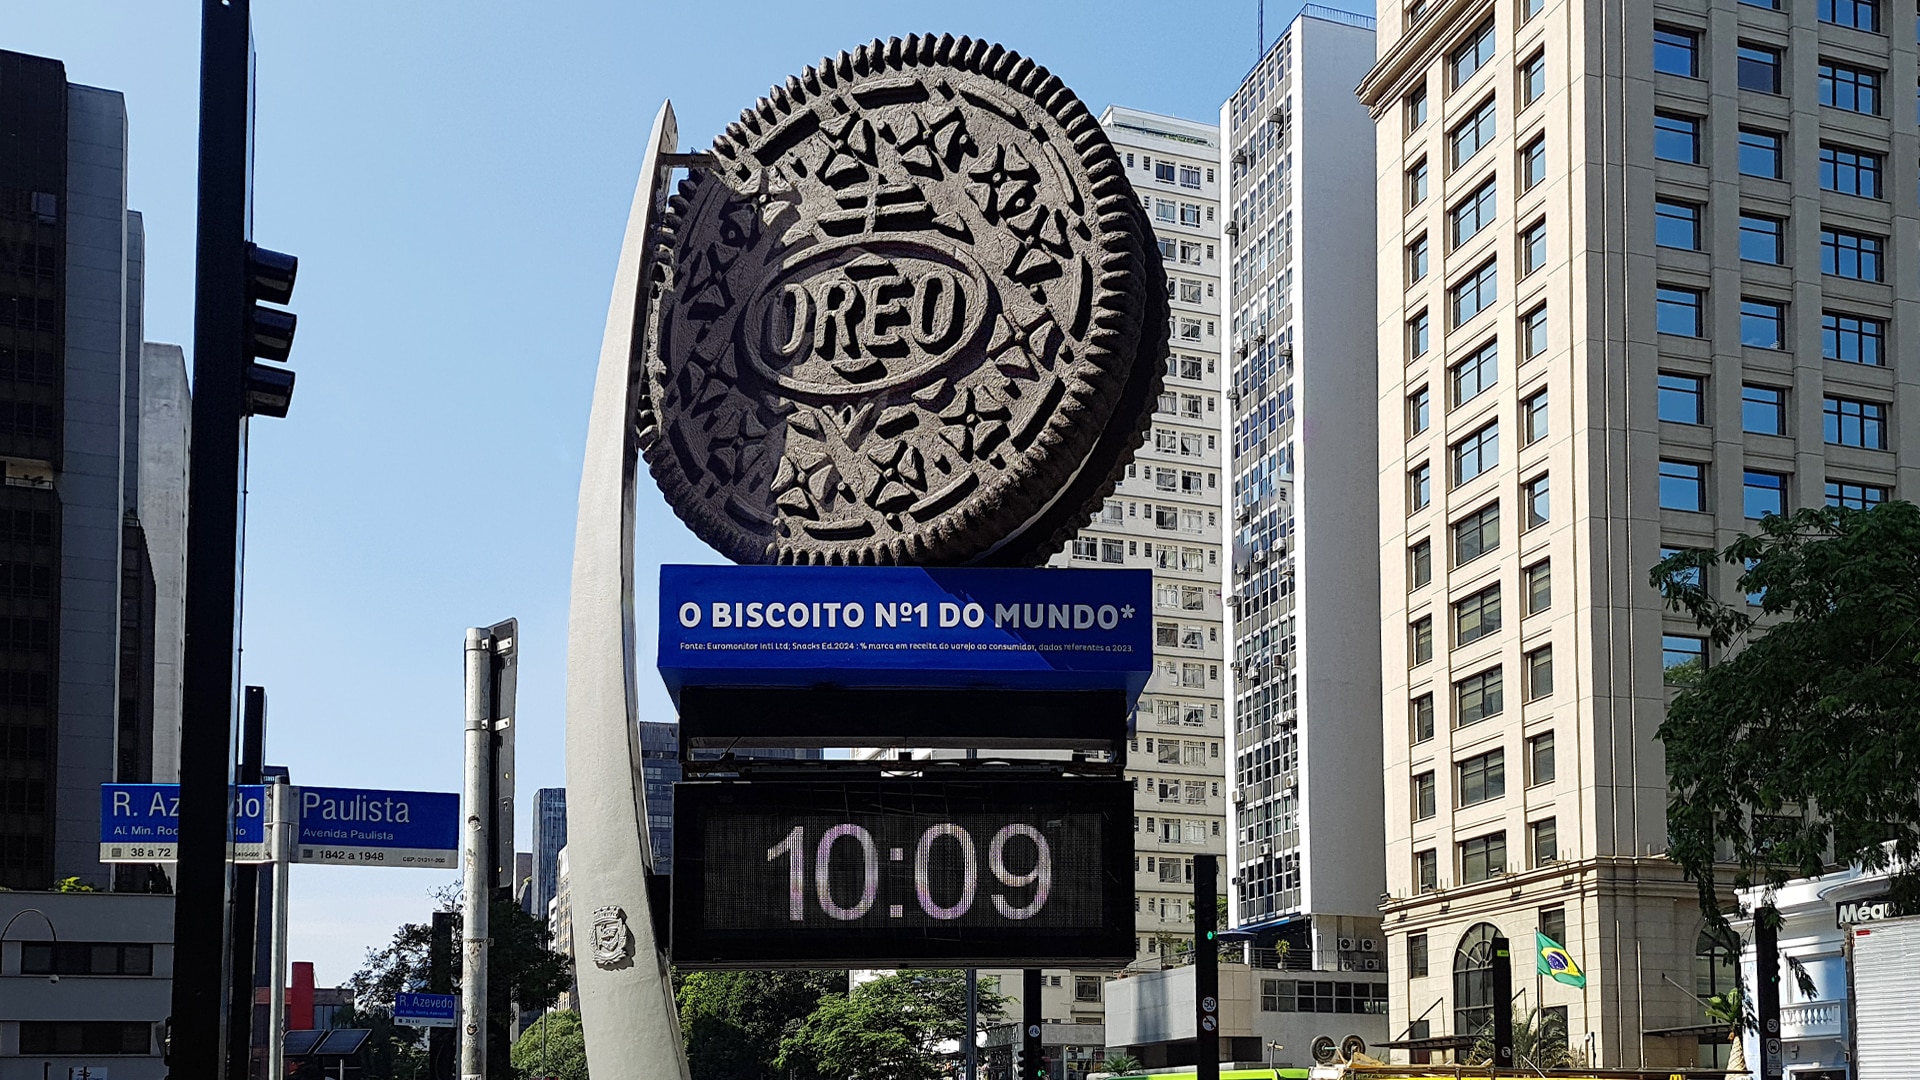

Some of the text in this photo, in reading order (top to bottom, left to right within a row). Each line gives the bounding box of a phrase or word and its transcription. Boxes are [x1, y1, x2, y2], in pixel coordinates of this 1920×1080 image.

[770, 269, 956, 355] OREO
[679, 602, 702, 628] O
[712, 602, 865, 628] BISCOITO
[939, 602, 985, 628] DO
[680, 642, 706, 650] Fonte:
[707, 642, 758, 650] Euromonitor
[775, 642, 791, 651] Ltd;
[792, 642, 820, 650] Snacks
[910, 642, 937, 650] receita
[939, 642, 949, 650] do
[951, 642, 976, 651] varejo
[989, 642, 1037, 651] consumidor,
[1039, 643, 1063, 651] dados
[1064, 643, 1104, 651] referentes
[113, 791, 138, 817] R.
[303, 792, 410, 823] Paulista
[114, 826, 127, 836] Al.
[131, 826, 154, 836] Min.
[302, 828, 394, 841] Avenida Paulista
[131, 848, 144, 857] 38
[158, 848, 171, 857] 72
[319, 850, 384, 861] 1842 a 1948
[767, 823, 1052, 920] 10:09
[400, 995, 453, 1009] R. Azevedo
[1204, 999, 1215, 1008] 50
